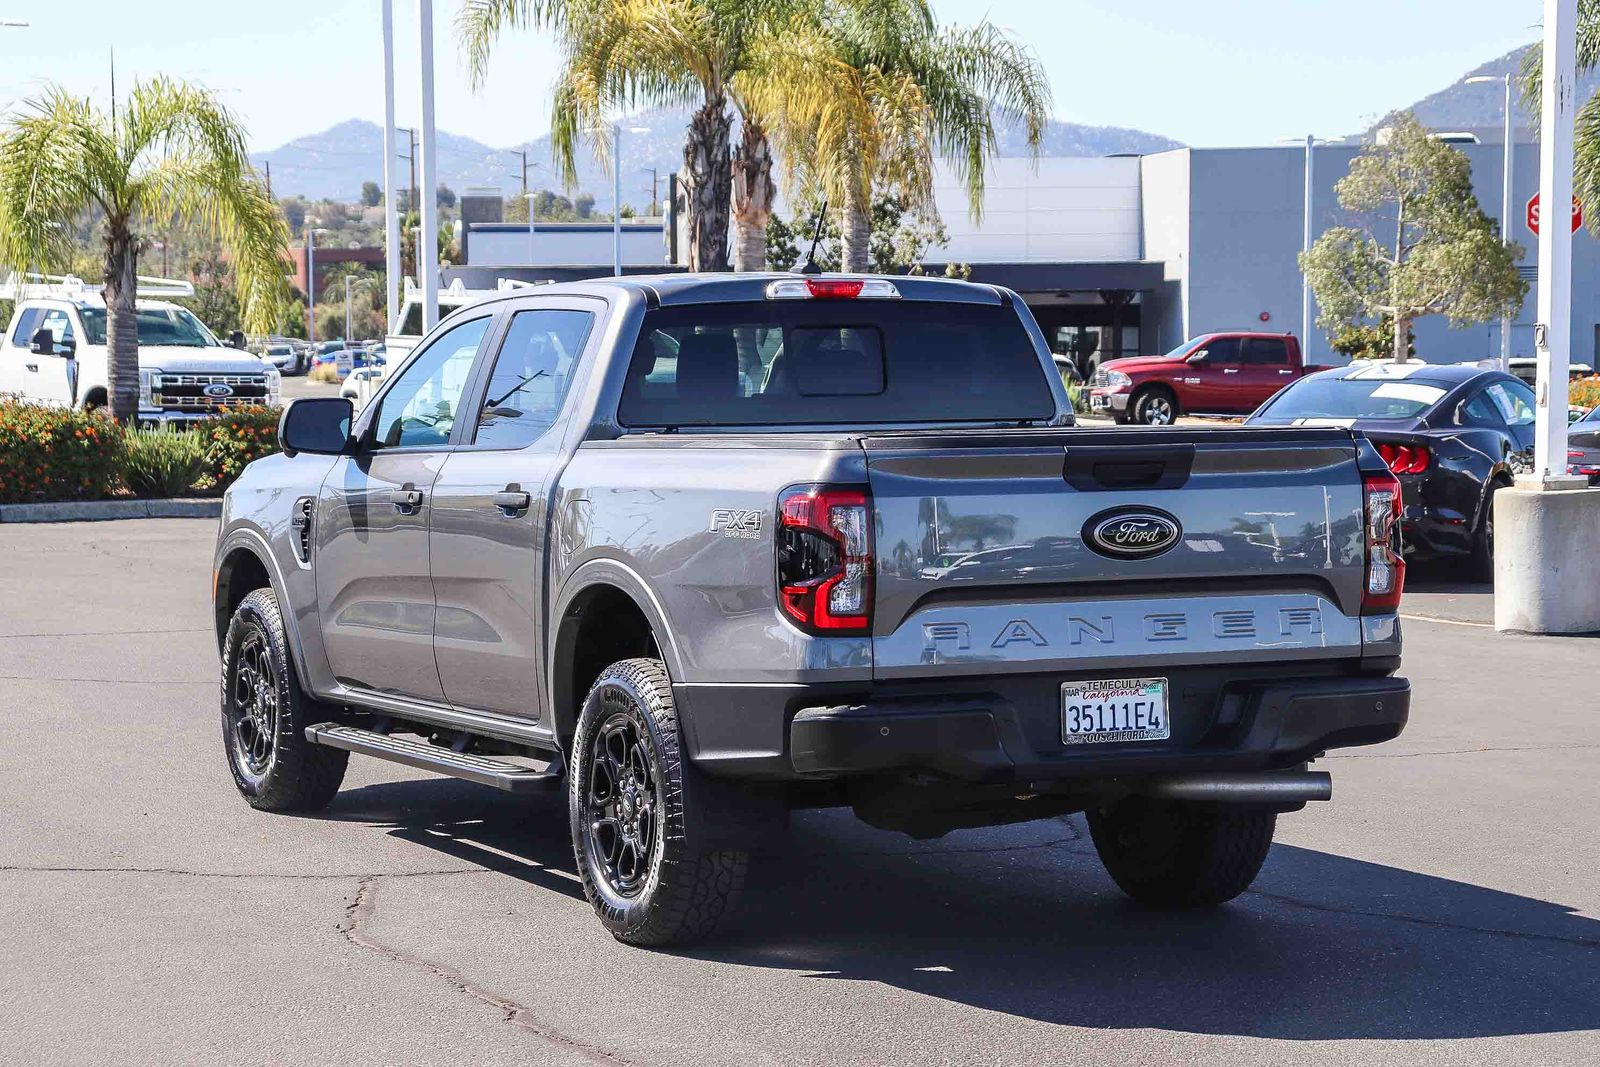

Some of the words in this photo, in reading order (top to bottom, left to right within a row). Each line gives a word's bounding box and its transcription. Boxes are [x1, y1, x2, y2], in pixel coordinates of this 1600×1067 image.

[1530, 204, 1578, 226] SP
[709, 508, 762, 533] FX4
[1115, 521, 1160, 543] Ford
[921, 606, 1322, 651] RANGER
[1065, 688, 1080, 697] MAR
[1082, 687, 1146, 703] California
[1086, 680, 1142, 691] TEMECULA
[1068, 701, 1160, 733] 35111E4
[1121, 730, 1145, 741] FORD
